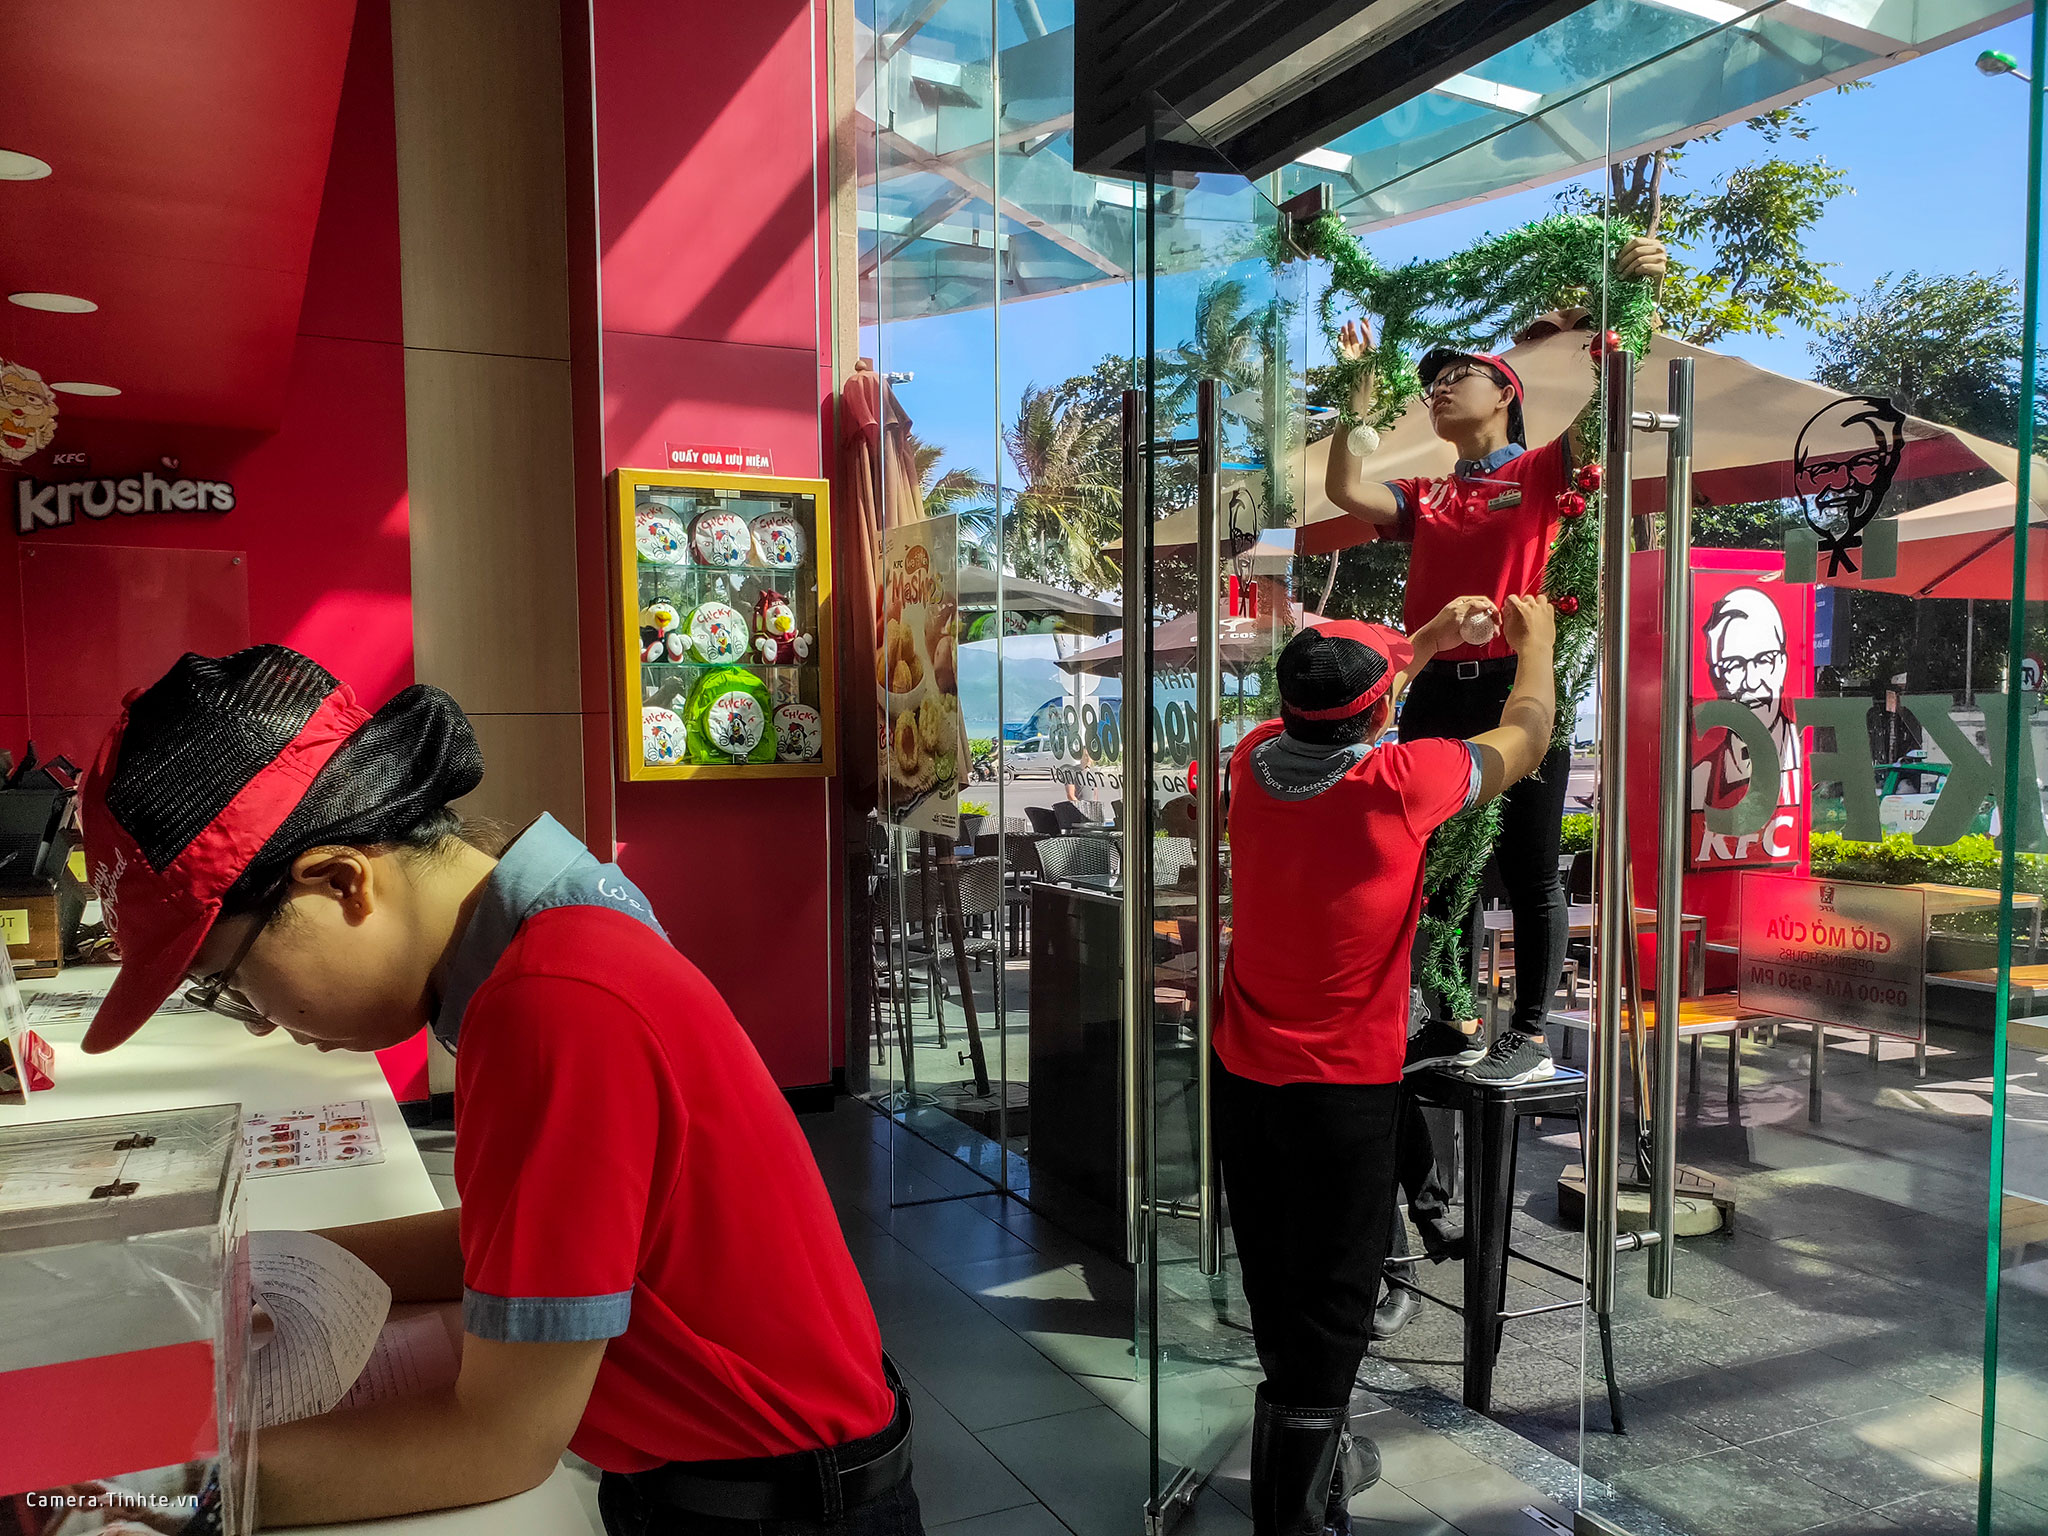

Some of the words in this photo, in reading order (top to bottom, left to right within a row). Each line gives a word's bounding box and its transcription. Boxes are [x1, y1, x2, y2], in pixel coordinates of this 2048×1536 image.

[53, 452, 86, 465] KFC
[702, 451, 723, 465] QUÀ
[725, 453, 743, 466] LƯU
[745, 454, 769, 469] NIỆM
[701, 513, 736, 530] CHICKY
[760, 517, 795, 529] CHICKY
[696, 608, 732, 624] CHICKY
[717, 698, 753, 710] CHICKY
[642, 711, 674, 725] HICKY
[782, 708, 818, 723] CHICKY
[1258, 760, 1283, 790] Finger
[1694, 815, 1794, 862] KFC
